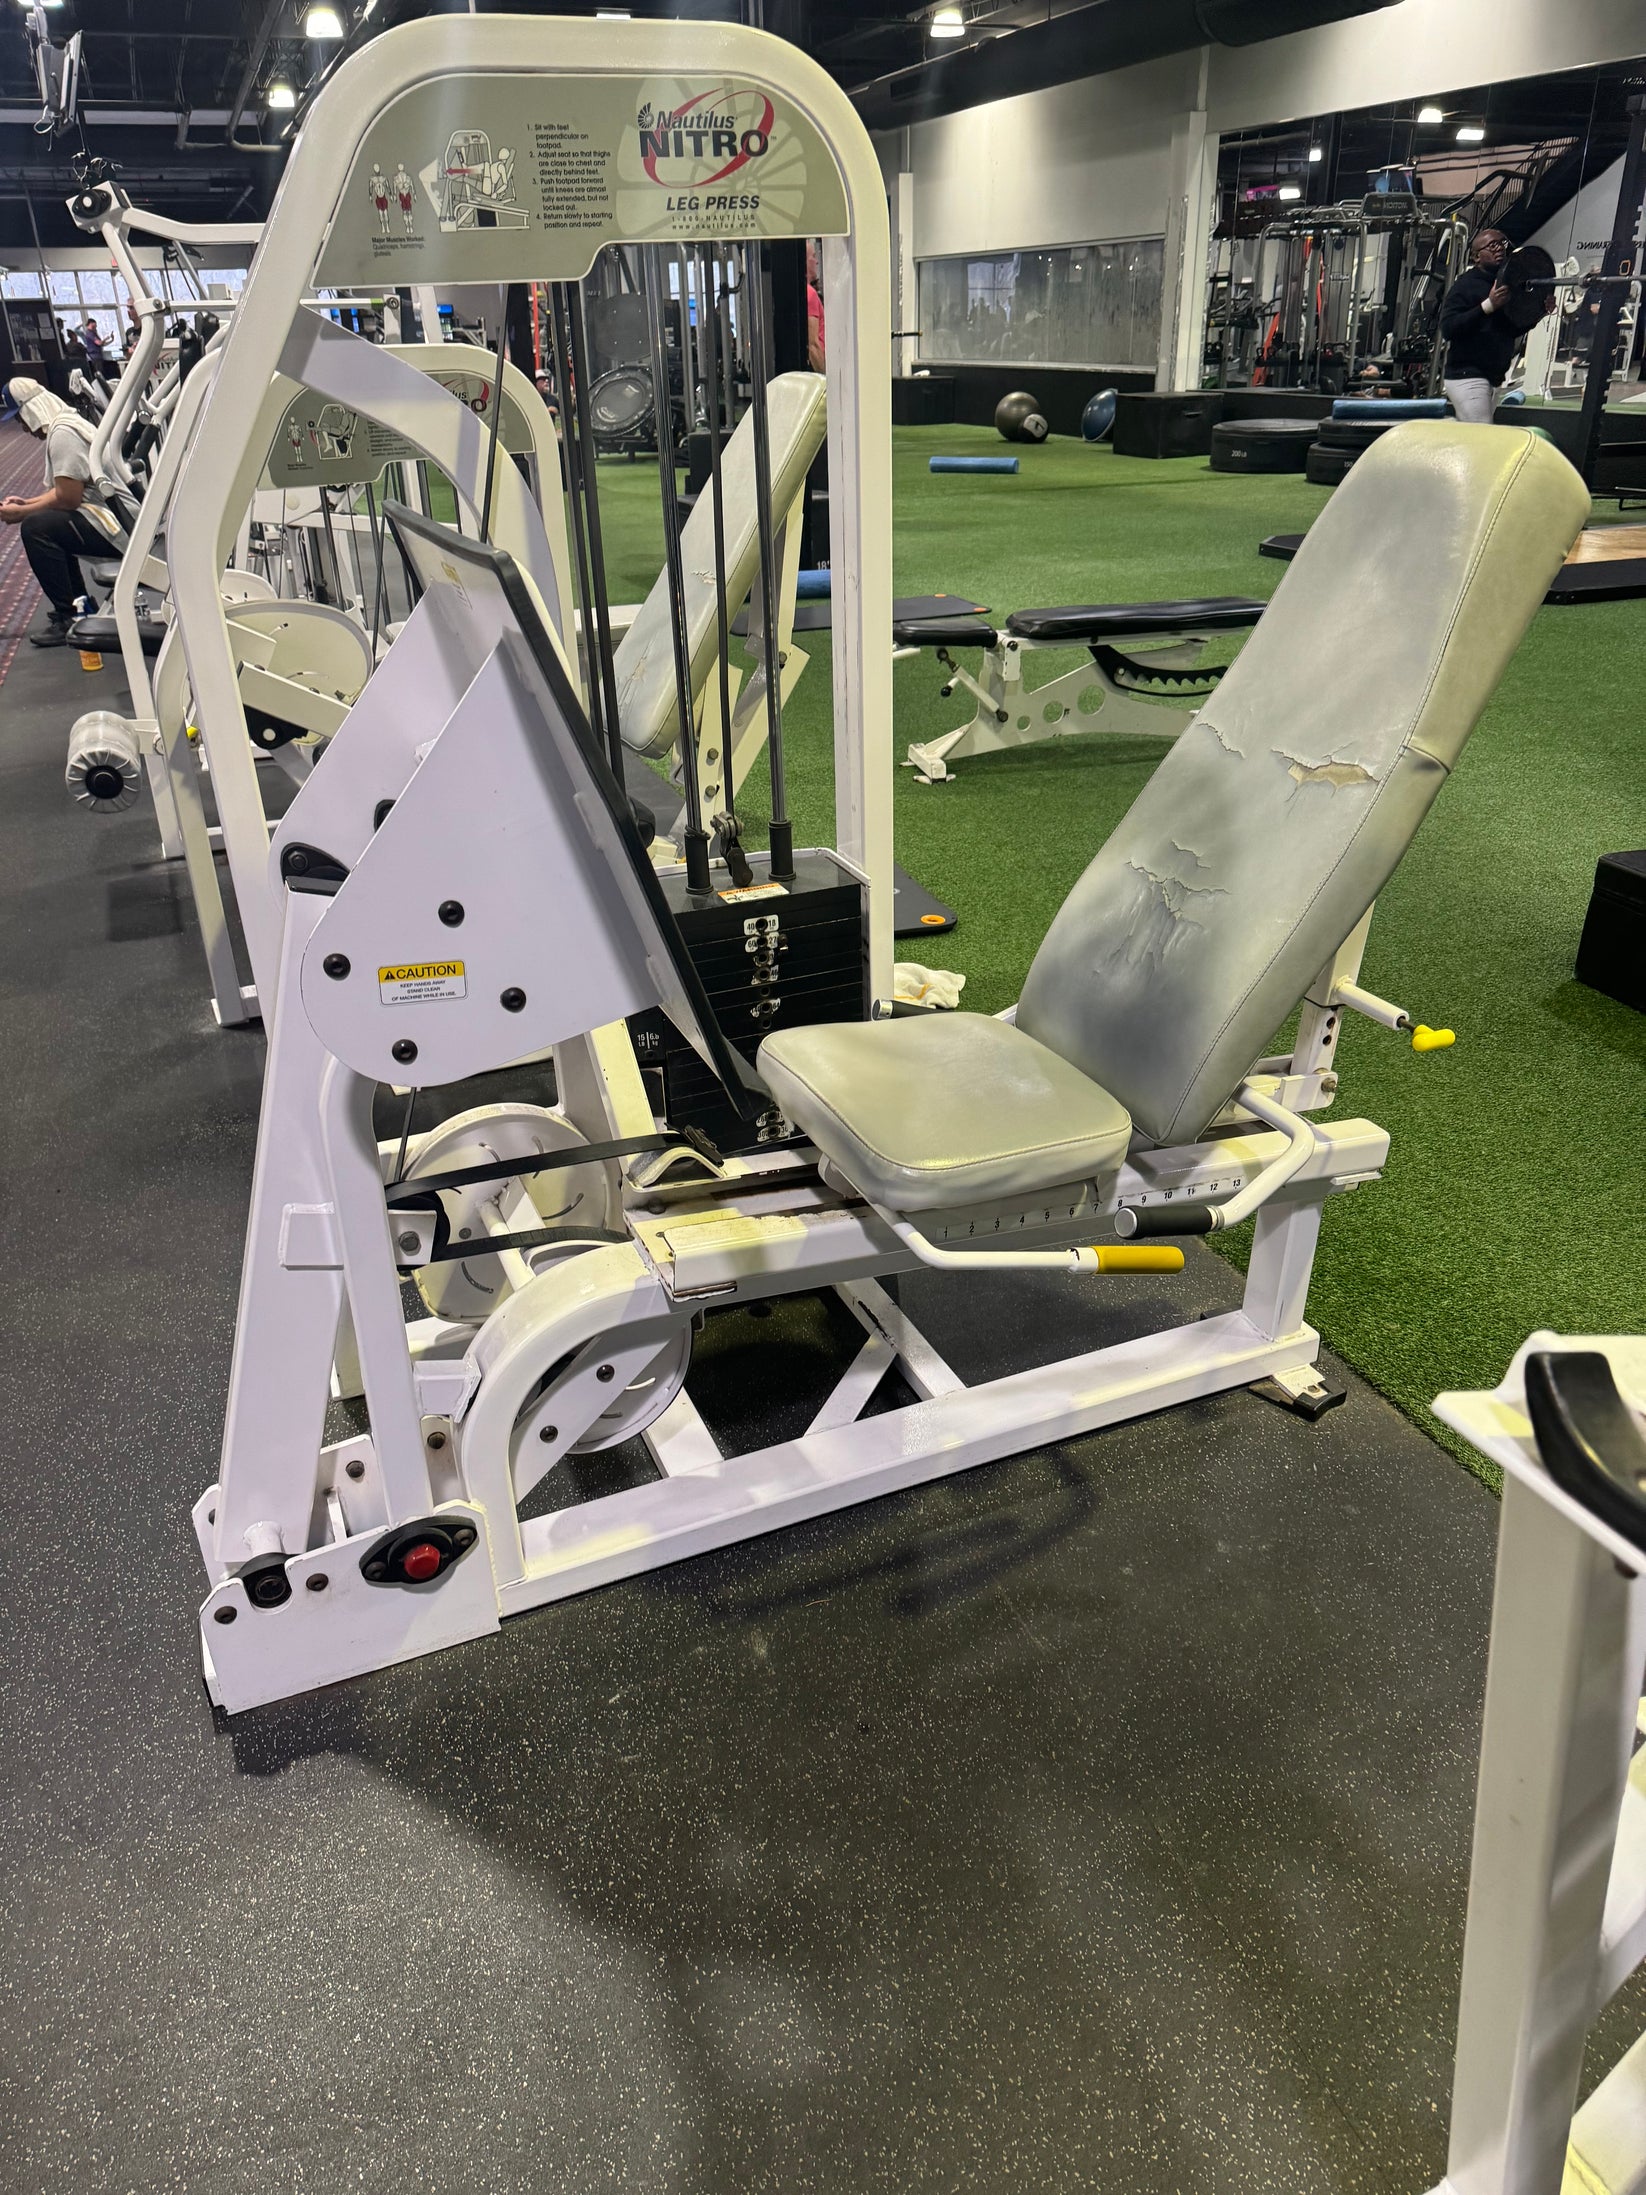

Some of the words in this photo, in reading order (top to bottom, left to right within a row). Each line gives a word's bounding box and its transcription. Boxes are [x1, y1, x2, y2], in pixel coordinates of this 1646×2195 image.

[656, 111, 735, 128] Nautilus
[536, 133, 579, 141] perpendicular
[639, 129, 768, 157] NITRO
[538, 151, 557, 159] Adjust
[556, 177, 579, 185] footpad
[666, 196, 700, 211] LEG
[705, 195, 760, 210] PRESS
[544, 222, 568, 230] position
[396, 964, 456, 980] CAUTION
[969, 1225, 975, 1233] 2
[994, 1220, 1000, 1229] 3
[1019, 1215, 1025, 1224] 4
[1044, 1211, 1050, 1219] 5
[1069, 1207, 1075, 1215] 6
[1093, 1203, 1099, 1213] 7
[1117, 1199, 1123, 1207] 8
[1141, 1195, 1147, 1204] 9
[1164, 1191, 1173, 1199] 10
[1187, 1187, 1195, 1195] 11
[1210, 1183, 1218, 1191] 12
[1232, 1179, 1241, 1187] 13
